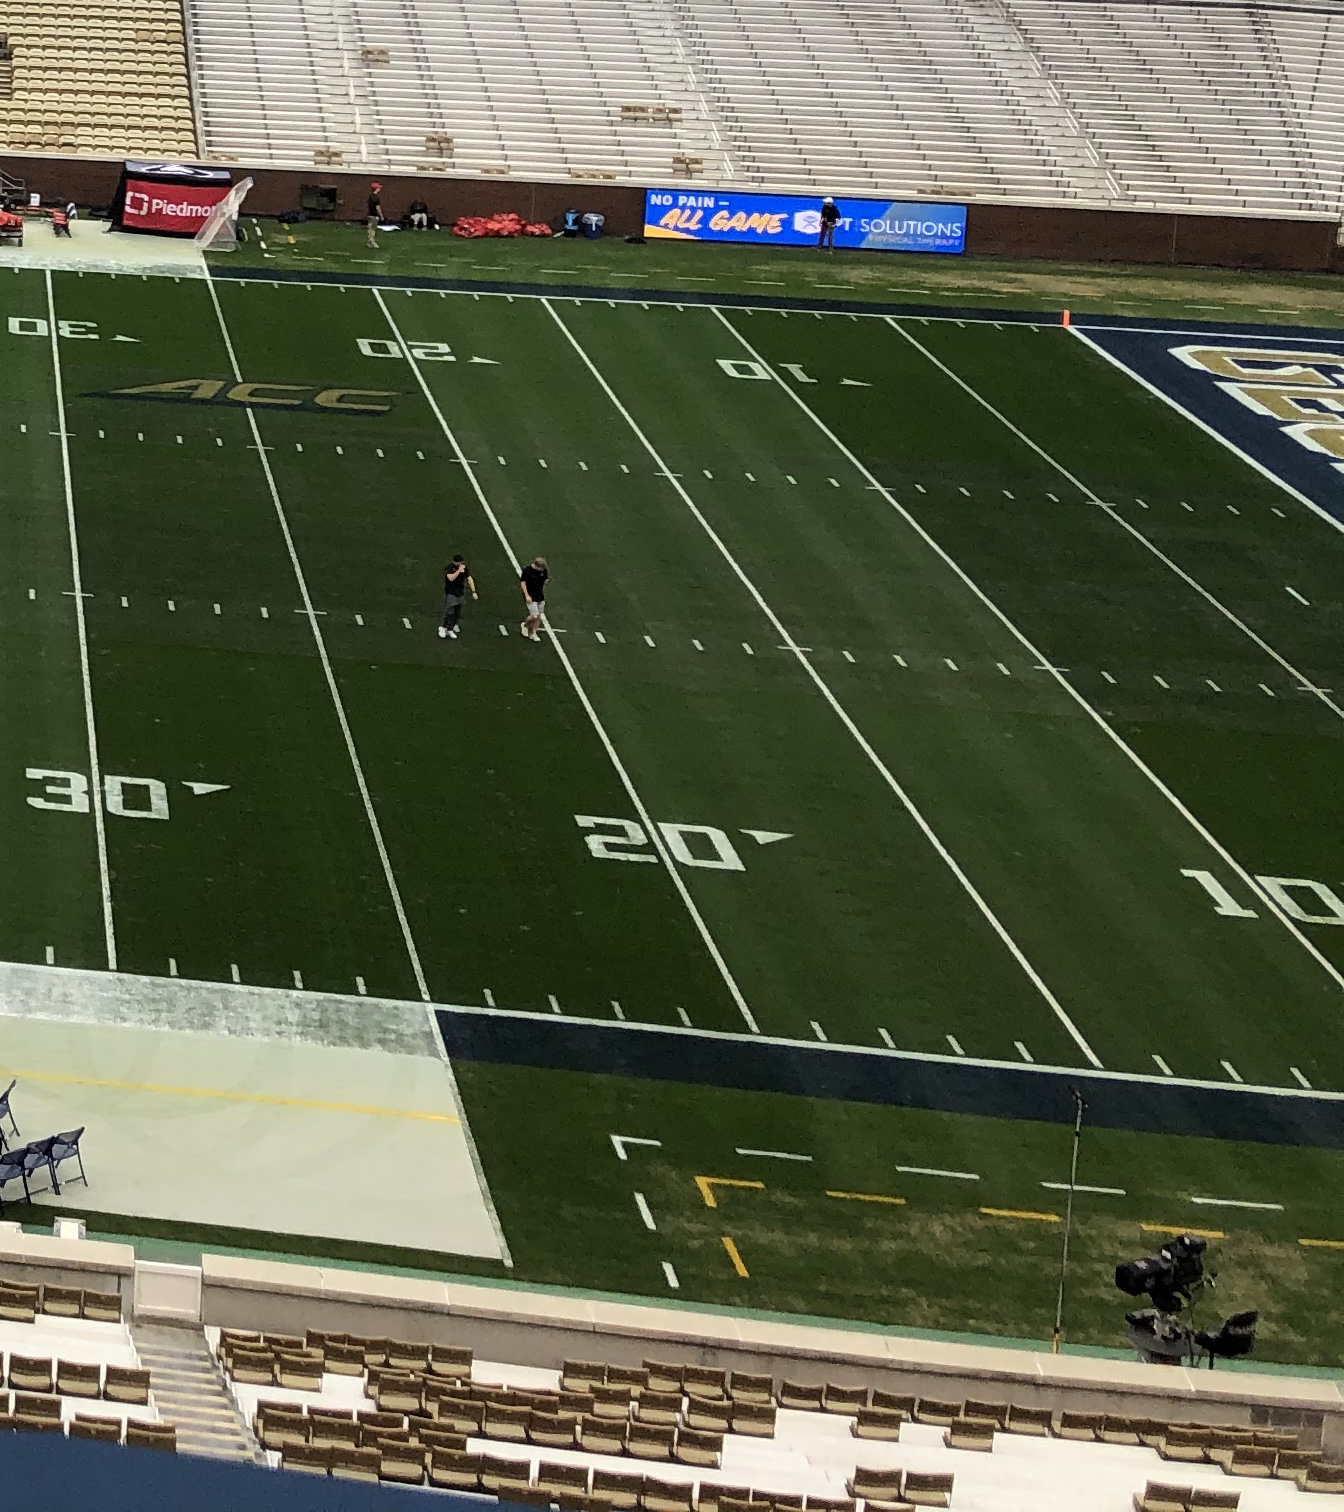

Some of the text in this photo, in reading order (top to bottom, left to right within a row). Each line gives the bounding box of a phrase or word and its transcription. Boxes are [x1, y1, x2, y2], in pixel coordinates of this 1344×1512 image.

[650, 194, 715, 208] NO PAIN
[659, 208, 789, 235] ALL GAME
[859, 219, 962, 237] SOLUTIONS
[104, 378, 404, 414] ACC
[25, 768, 169, 820] 30
[574, 814, 746, 872] 20
[1180, 868, 1344, 926] 10
